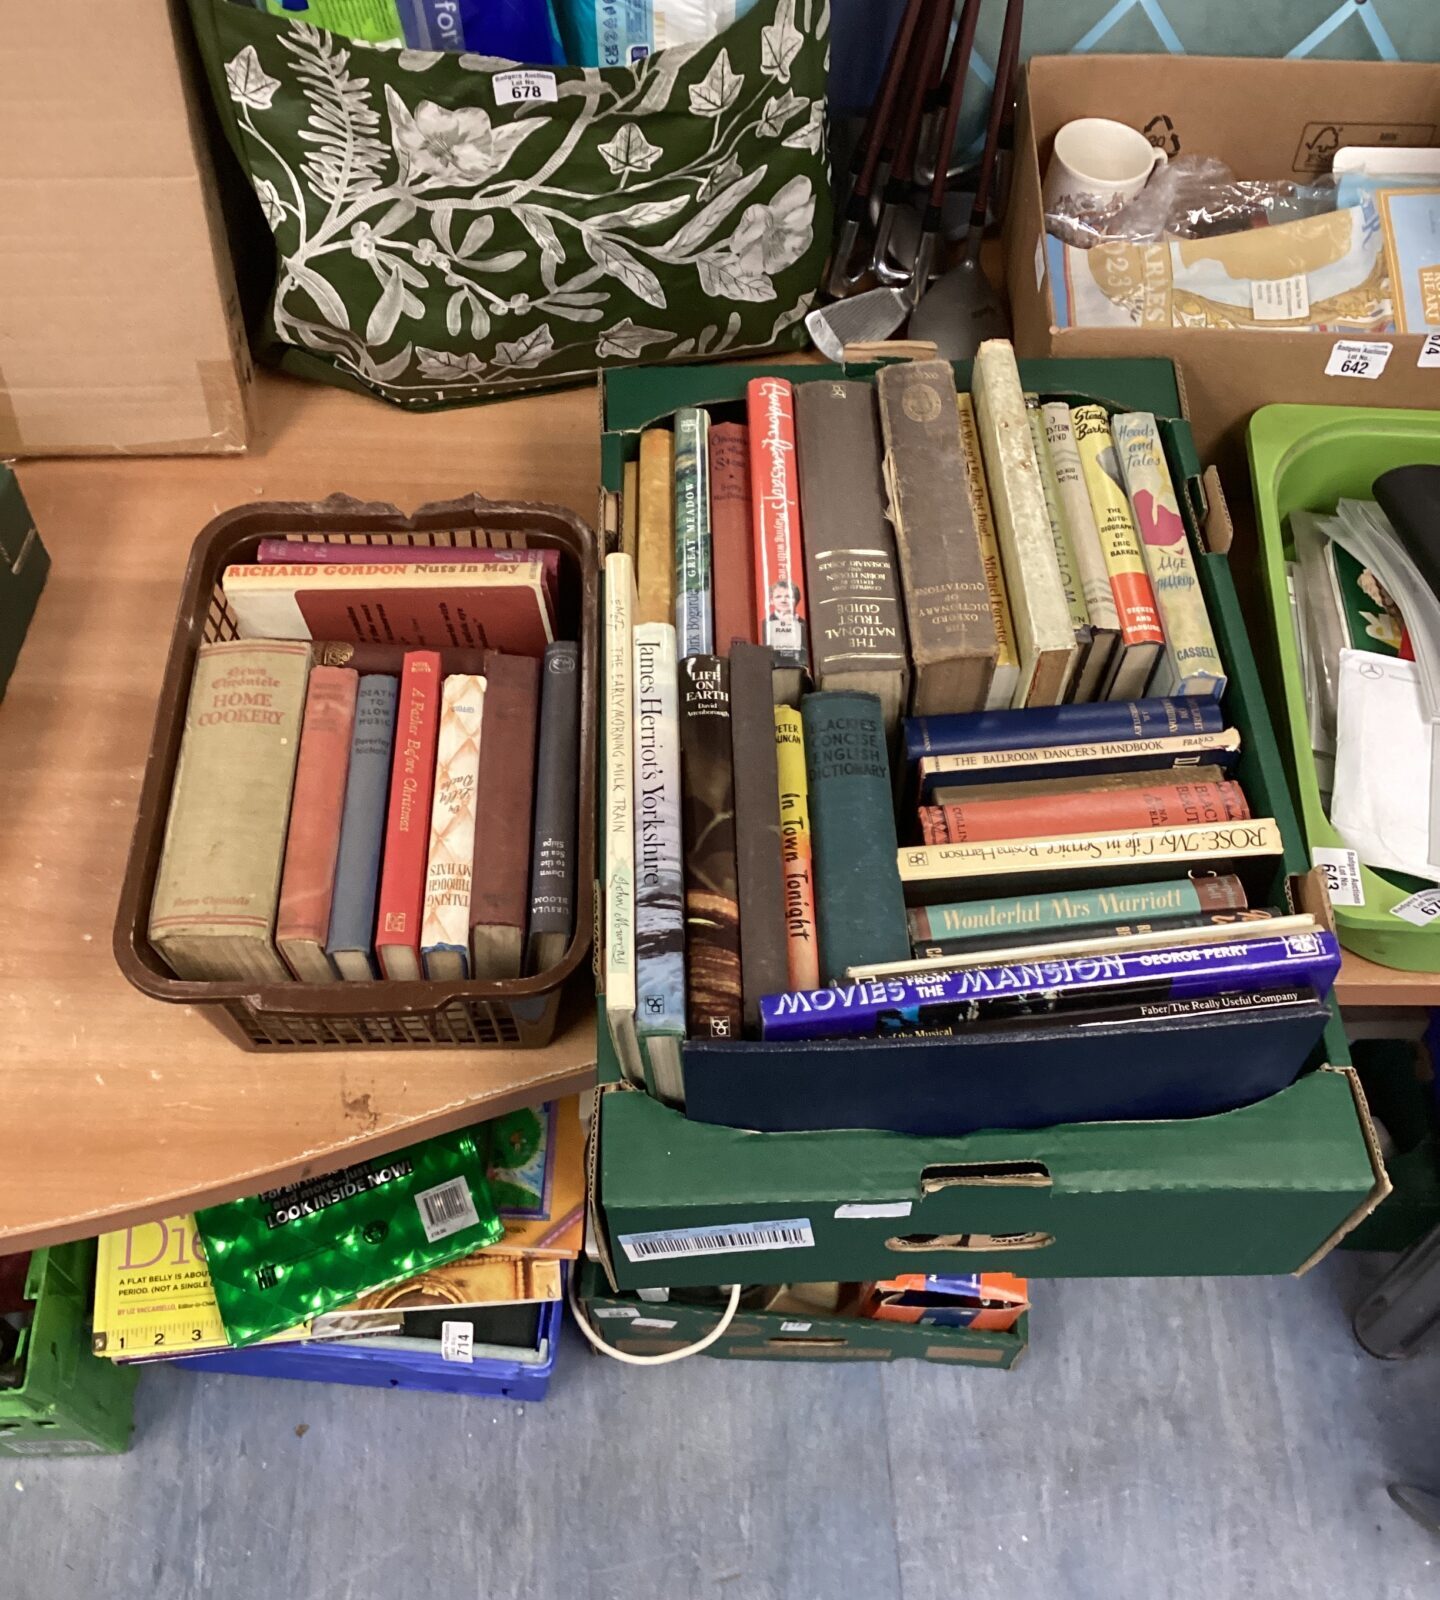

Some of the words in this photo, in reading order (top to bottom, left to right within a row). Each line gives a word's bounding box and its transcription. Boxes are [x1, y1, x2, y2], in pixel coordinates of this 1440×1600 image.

[512, 86, 541, 98] 678
[1423, 271, 1439, 320] HEART
[1341, 360, 1369, 374] 642
[1074, 407, 1107, 426] Steady
[1118, 422, 1155, 437] Heads
[1128, 439, 1154, 453] and
[1126, 453, 1161, 471] Tales
[685, 480, 695, 534] MEADOW
[774, 512, 784, 543] Playing
[686, 539, 696, 577] GREAT
[775, 544, 786, 561] with
[228, 564, 320, 578] RICHARD
[323, 564, 408, 577] GORDON
[413, 564, 453, 574] Nuts
[483, 563, 520, 576] May
[777, 563, 786, 579] Fire
[983, 556, 1002, 597] Michael
[914, 582, 985, 595] QUOTATIONS
[687, 588, 700, 632] Bogarde
[838, 603, 880, 614] GUIDE
[919, 603, 990, 617] DICTIONARY
[839, 615, 883, 626] TRUST
[932, 613, 979, 625] OXFORD
[825, 626, 896, 639] NATIONAL
[850, 638, 877, 648] THE
[1176, 645, 1217, 660] CASSELL
[636, 639, 660, 695] James
[691, 670, 721, 681] LIFE
[211, 677, 281, 690] Chronicle
[695, 681, 715, 690] ON
[213, 692, 273, 708] HOME
[686, 690, 730, 702] EARTH
[197, 709, 286, 727] COOKERY
[360, 708, 391, 717] SLOW
[640, 698, 663, 781] Herriot's
[810, 733, 879, 748] CONCISE
[811, 748, 880, 764] ENGLISH
[953, 755, 978, 767] THE
[982, 751, 1039, 765] BALLROOM
[1043, 745, 1098, 760] DANCER'S
[1100, 739, 1165, 755] HANDBOOK
[611, 762, 626, 791] MILK
[809, 763, 888, 779] DICTIONARY
[780, 793, 801, 810] In
[612, 797, 626, 833] TRAIN
[642, 783, 666, 885] Yorkshire
[782, 816, 804, 862] Town
[1159, 831, 1199, 851] My
[540, 849, 550, 857] in
[552, 849, 566, 858] Sea
[939, 846, 997, 861] Harrison
[1000, 843, 1040, 857] Rosina
[1045, 839, 1102, 860] Service
[1106, 841, 1121, 852] in
[1125, 837, 1156, 856] Life
[429, 863, 458, 876] HATS
[459, 863, 472, 877] MY
[540, 859, 554, 868] the
[556, 859, 565, 867] to
[1338, 865, 1347, 876] Lot
[429, 878, 471, 892] THROUGH
[1350, 878, 1361, 904] Auctions
[427, 894, 470, 907] TALKING
[534, 896, 568, 905] BLOOM
[785, 870, 810, 941] Tonight
[532, 905, 569, 915] URSULA
[942, 901, 1043, 930] Wonderful
[1050, 897, 1092, 921] Mrs
[1098, 888, 1183, 914] Marriott
[1139, 950, 1201, 966] GEORGE
[1203, 944, 1249, 961] PERRY
[907, 973, 951, 986] FROM
[957, 953, 1126, 994] MANSION
[774, 981, 906, 1016] MOVIES
[916, 984, 944, 998] THE
[1190, 999, 1221, 1013] Really
[1221, 995, 1252, 1008] Useful
[1253, 991, 1299, 1006] Company
[914, 1026, 953, 1037] Musical
[268, 1200, 314, 1229] LOOK
[314, 1181, 367, 1210] INSIDE
[368, 1160, 413, 1185] NOW!
[127, 1276, 146, 1285] FLAT
[148, 1273, 172, 1283] BELLY
[184, 1270, 210, 1279] ABOU
[118, 1287, 149, 1296] PERIOD.
[151, 1284, 172, 1294] (NOT
[180, 1281, 209, 1290] SINGLE
[120, 1336, 125, 1349] 1
[154, 1333, 165, 1346] 2
[191, 1329, 203, 1341] 3
[457, 1335, 470, 1356] 714
